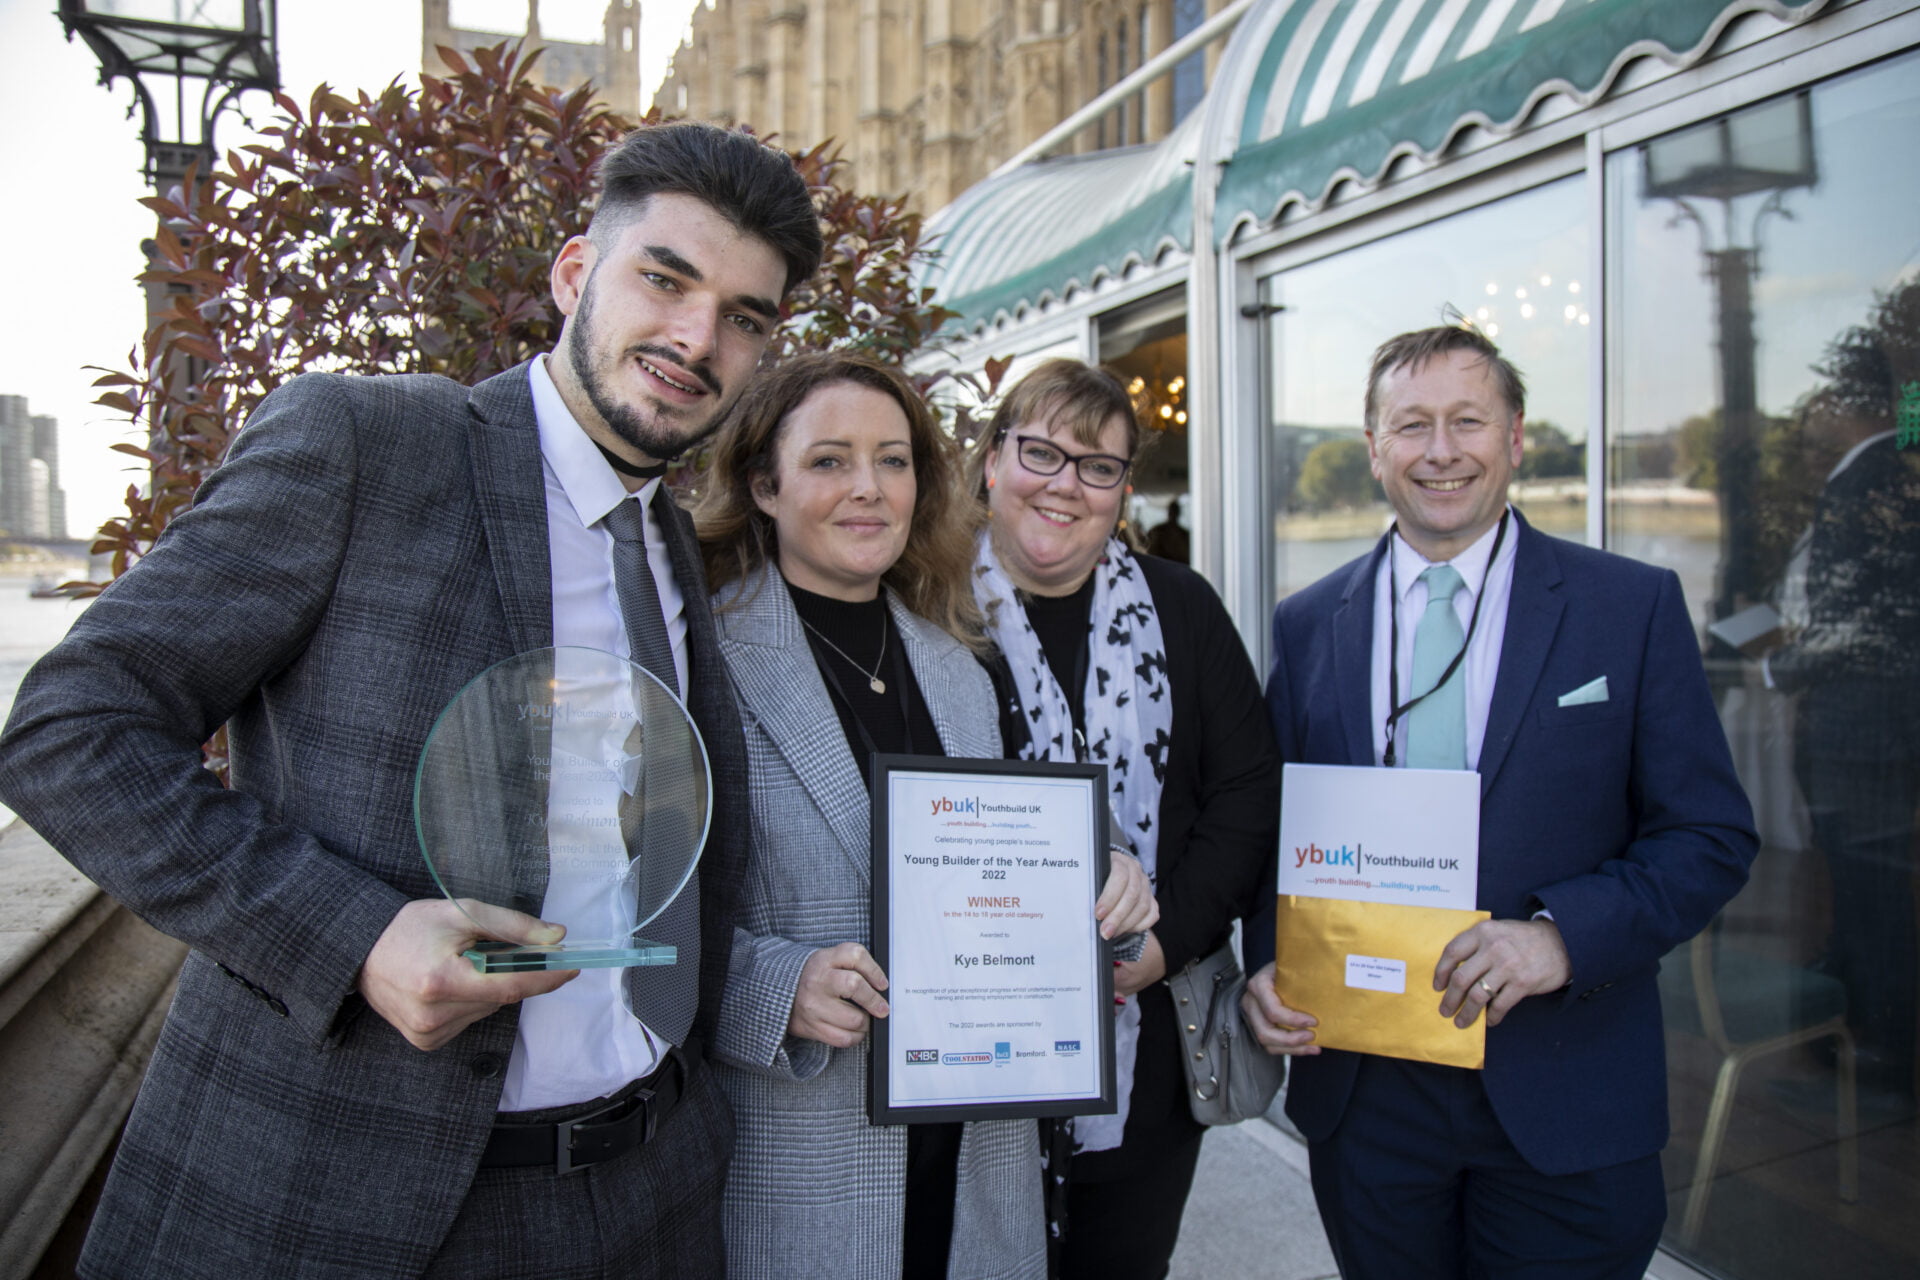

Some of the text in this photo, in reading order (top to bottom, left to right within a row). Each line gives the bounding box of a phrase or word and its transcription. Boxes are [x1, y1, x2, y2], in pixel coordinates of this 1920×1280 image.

[620, 711, 634, 719] UK
[613, 757, 625, 767] of
[534, 770, 551, 780] the
[586, 772, 616, 782] 2022
[931, 796, 1042, 816] ybuk Youthbuild UK
[934, 836, 973, 845] Celebrating
[996, 837, 1023, 846] people's
[904, 854, 1079, 868] Young Builder of the Year Awards
[1295, 843, 1460, 870] ybuk Youthbuild UK
[982, 870, 1006, 880] 2022
[968, 896, 1021, 908] WINNER
[954, 954, 1035, 968] Kye Belmont
[907, 1051, 938, 1062] NHBC
[945, 1053, 991, 1063] TOOLSTATION
